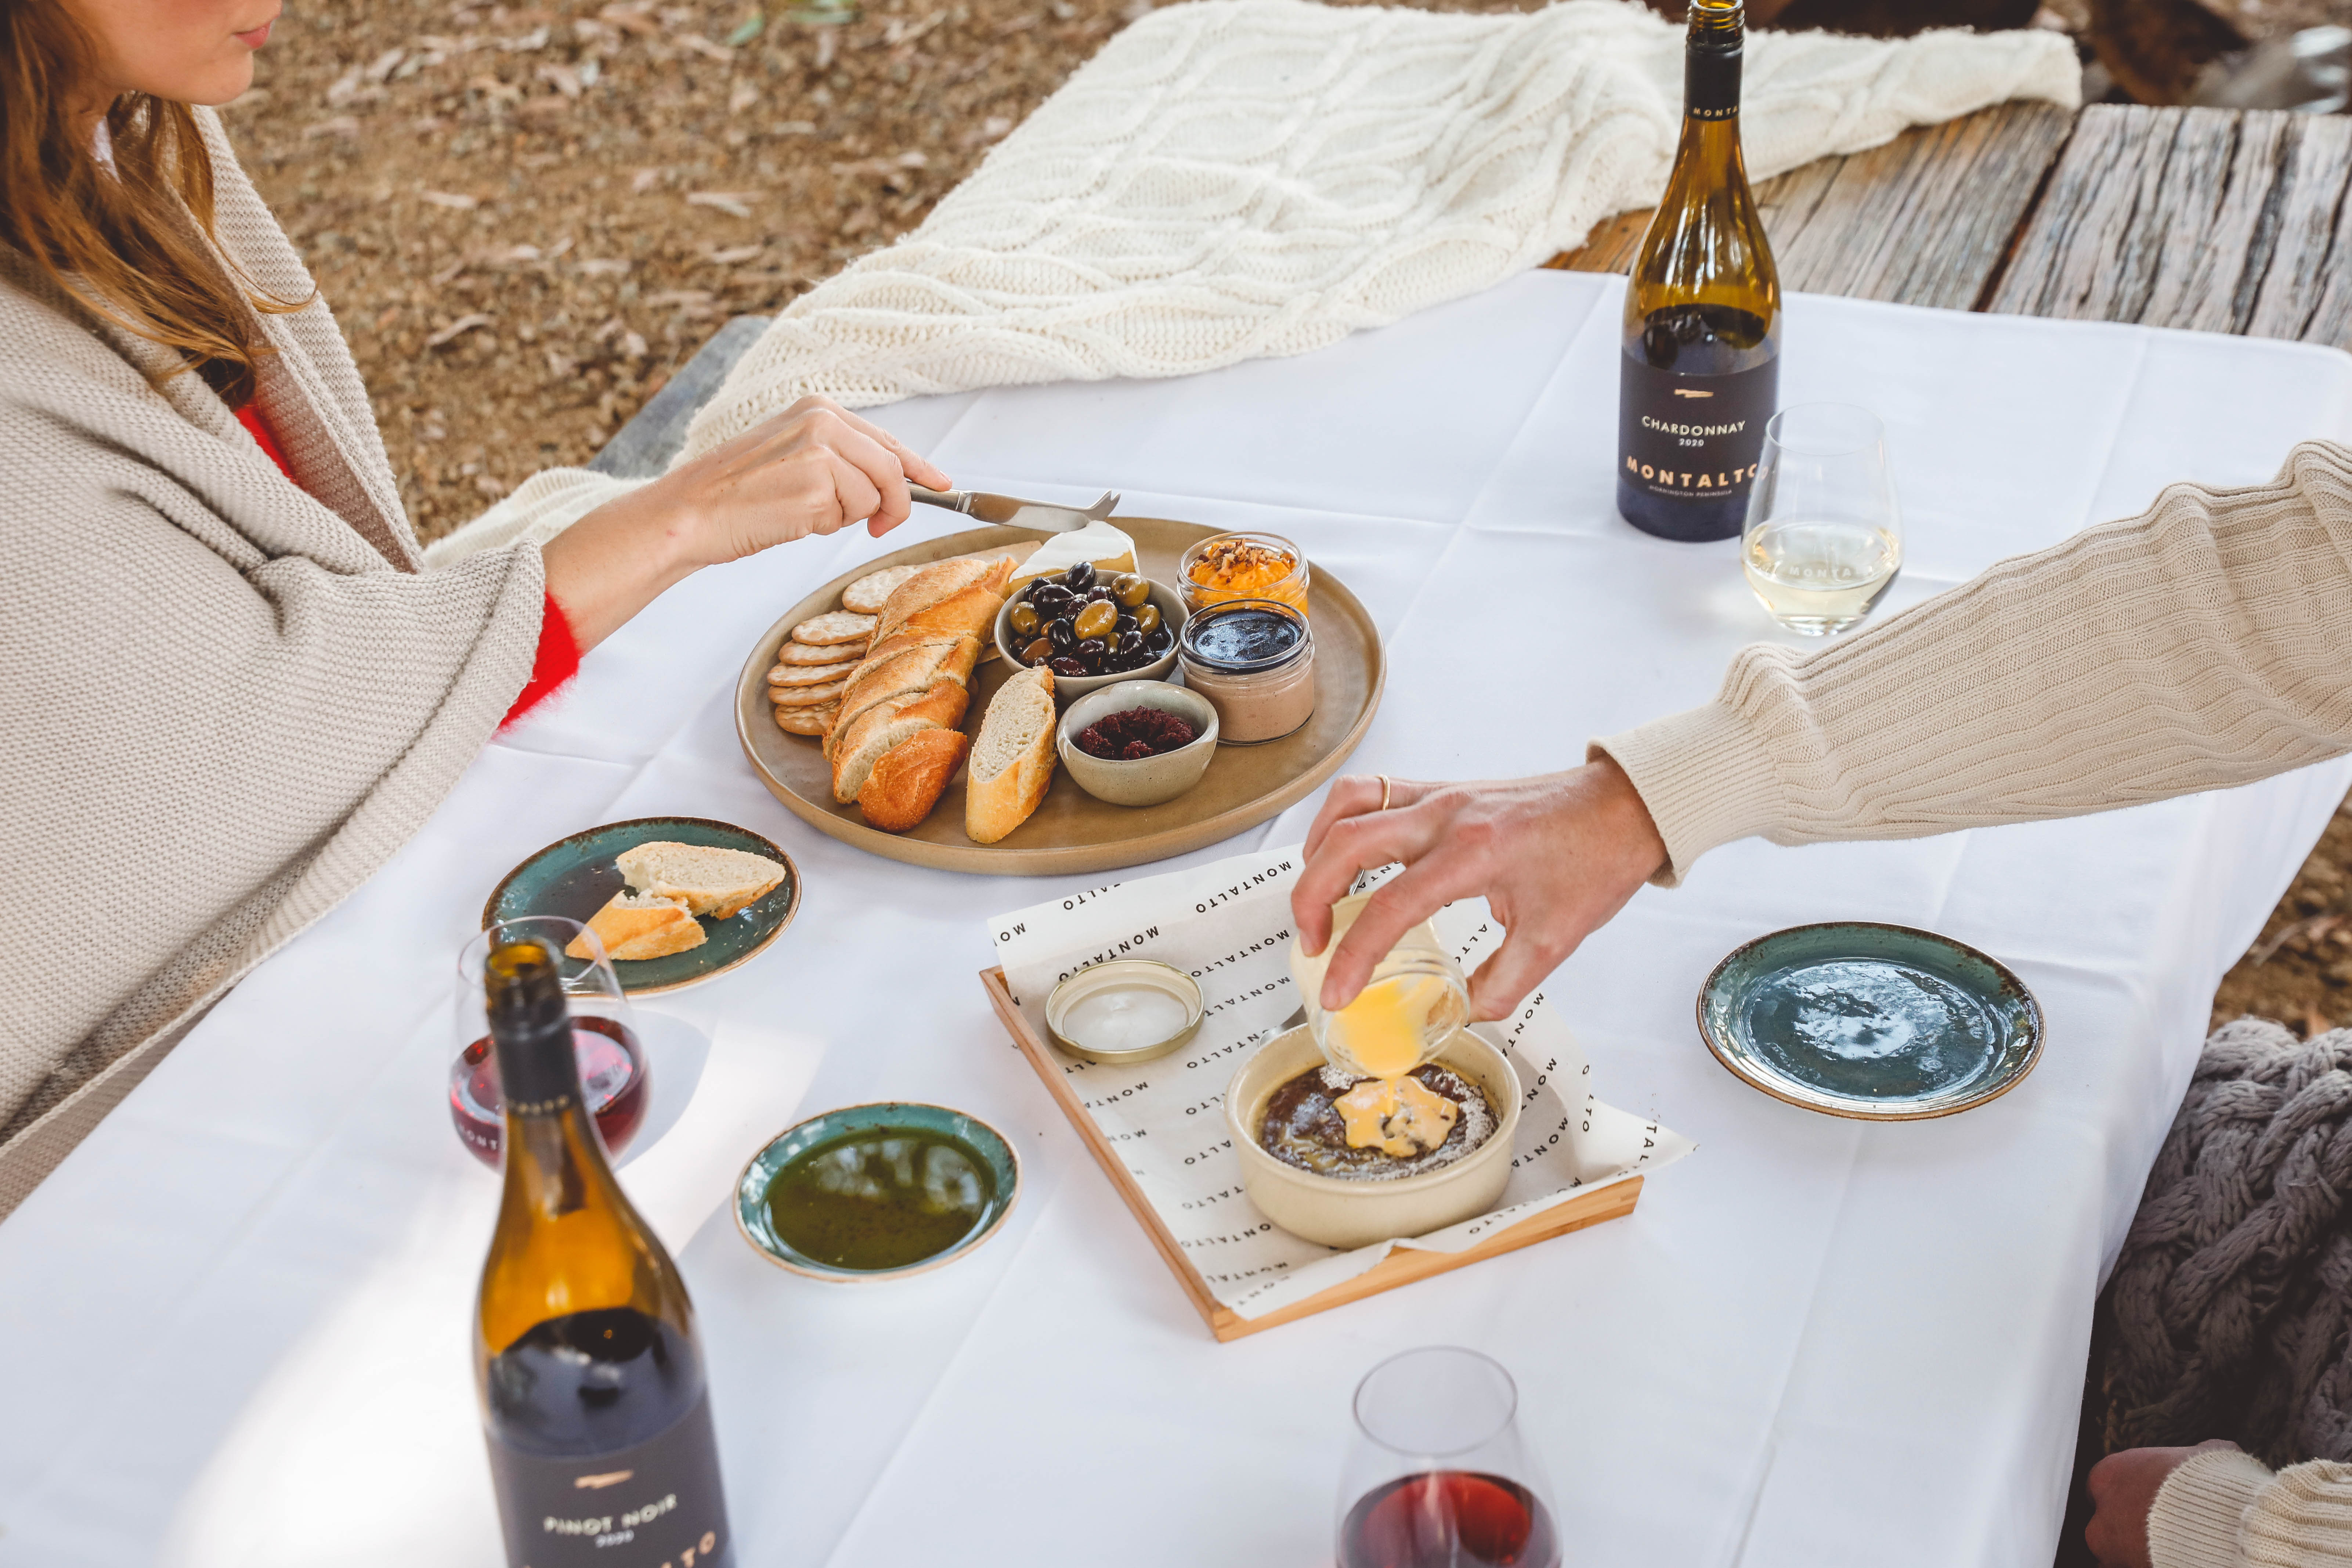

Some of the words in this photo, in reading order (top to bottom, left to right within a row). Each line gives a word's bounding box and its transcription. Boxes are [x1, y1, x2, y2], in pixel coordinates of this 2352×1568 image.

[1641, 416, 1746, 436] CHARDONNAY
[1679, 438, 1704, 447] 2020
[1196, 861, 1292, 913] MONTALTO
[993, 922, 1026, 946] MO
[1191, 929, 1290, 977] MONTALTO
[1186, 1092, 1226, 1115] LTO
[1185, 1139, 1232, 1165] ALTO
[543, 1516, 613, 1536] PINOT
[621, 1493, 677, 1528] NOIR
